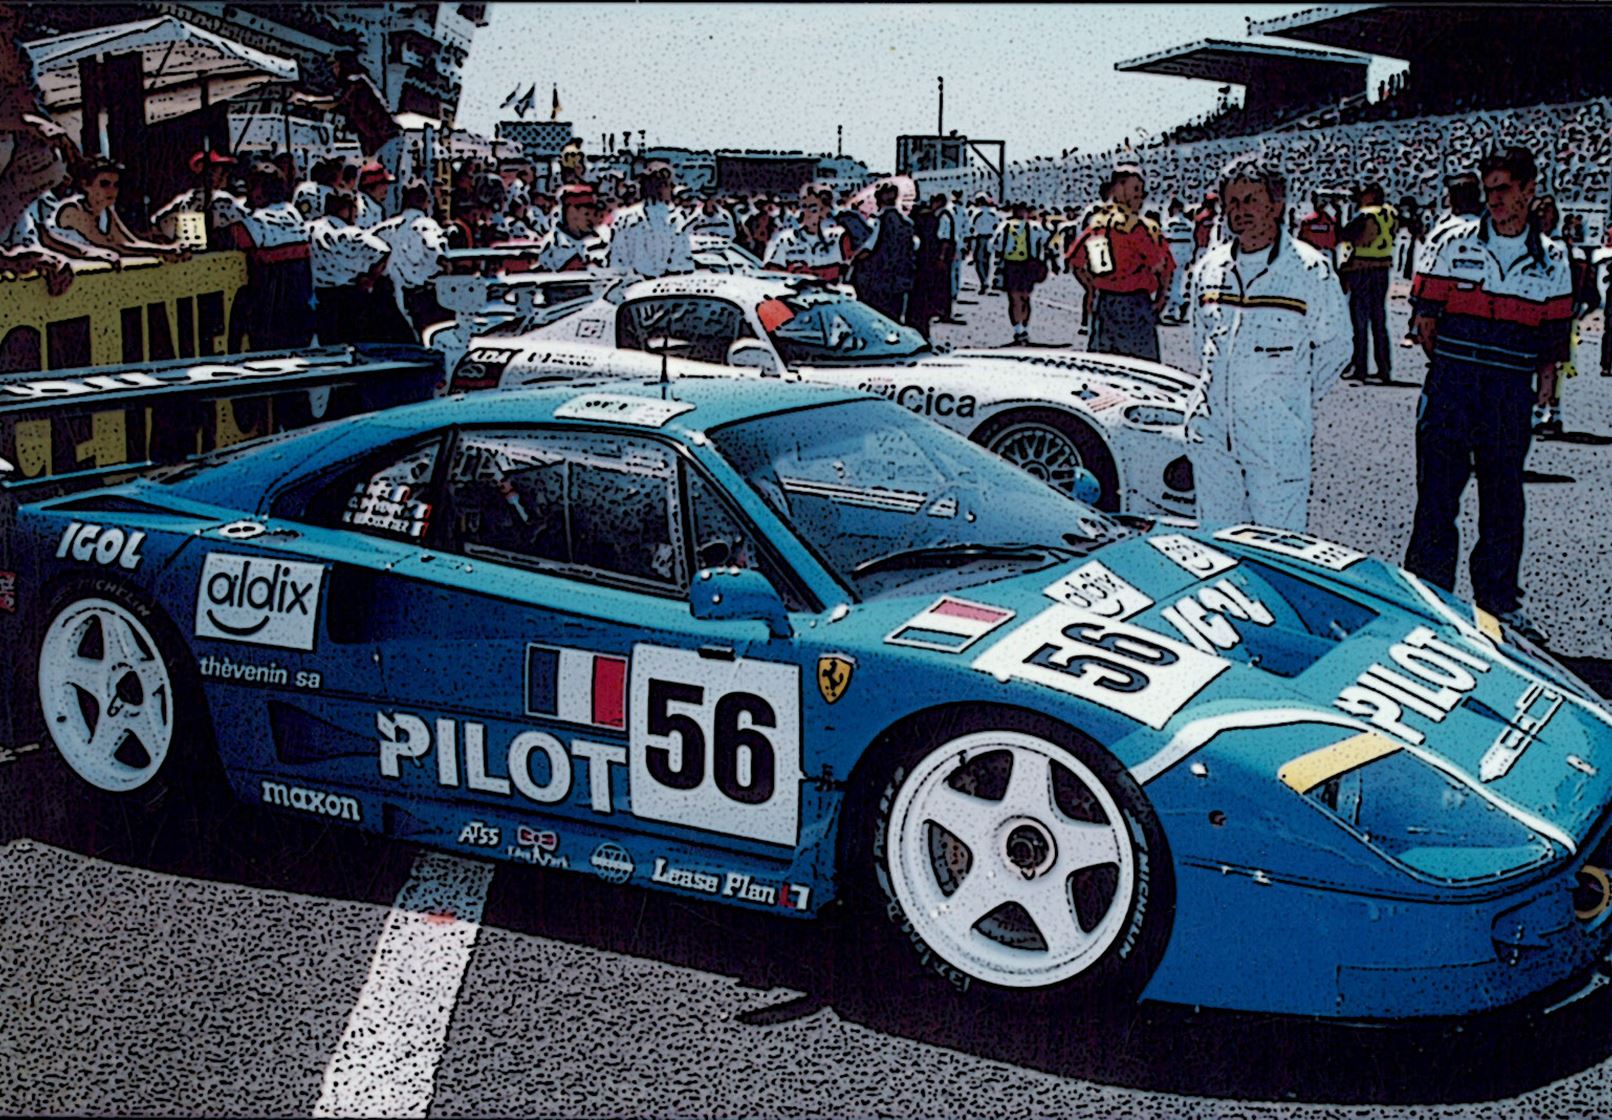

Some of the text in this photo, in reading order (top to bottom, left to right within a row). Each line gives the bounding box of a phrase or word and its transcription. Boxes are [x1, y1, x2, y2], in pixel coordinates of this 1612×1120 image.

[56, 522, 147, 571] IGOL
[206, 560, 313, 616] aldix
[295, 669, 321, 689] sa
[1022, 622, 1180, 694] 56
[1333, 625, 1492, 746] PILOT
[376, 708, 627, 814] PILOT
[645, 678, 777, 805] 56
[262, 780, 361, 822] maxon
[651, 857, 719, 893] Lease
[721, 871, 776, 905] Plan
[1119, 851, 1150, 960] MICHELIN
